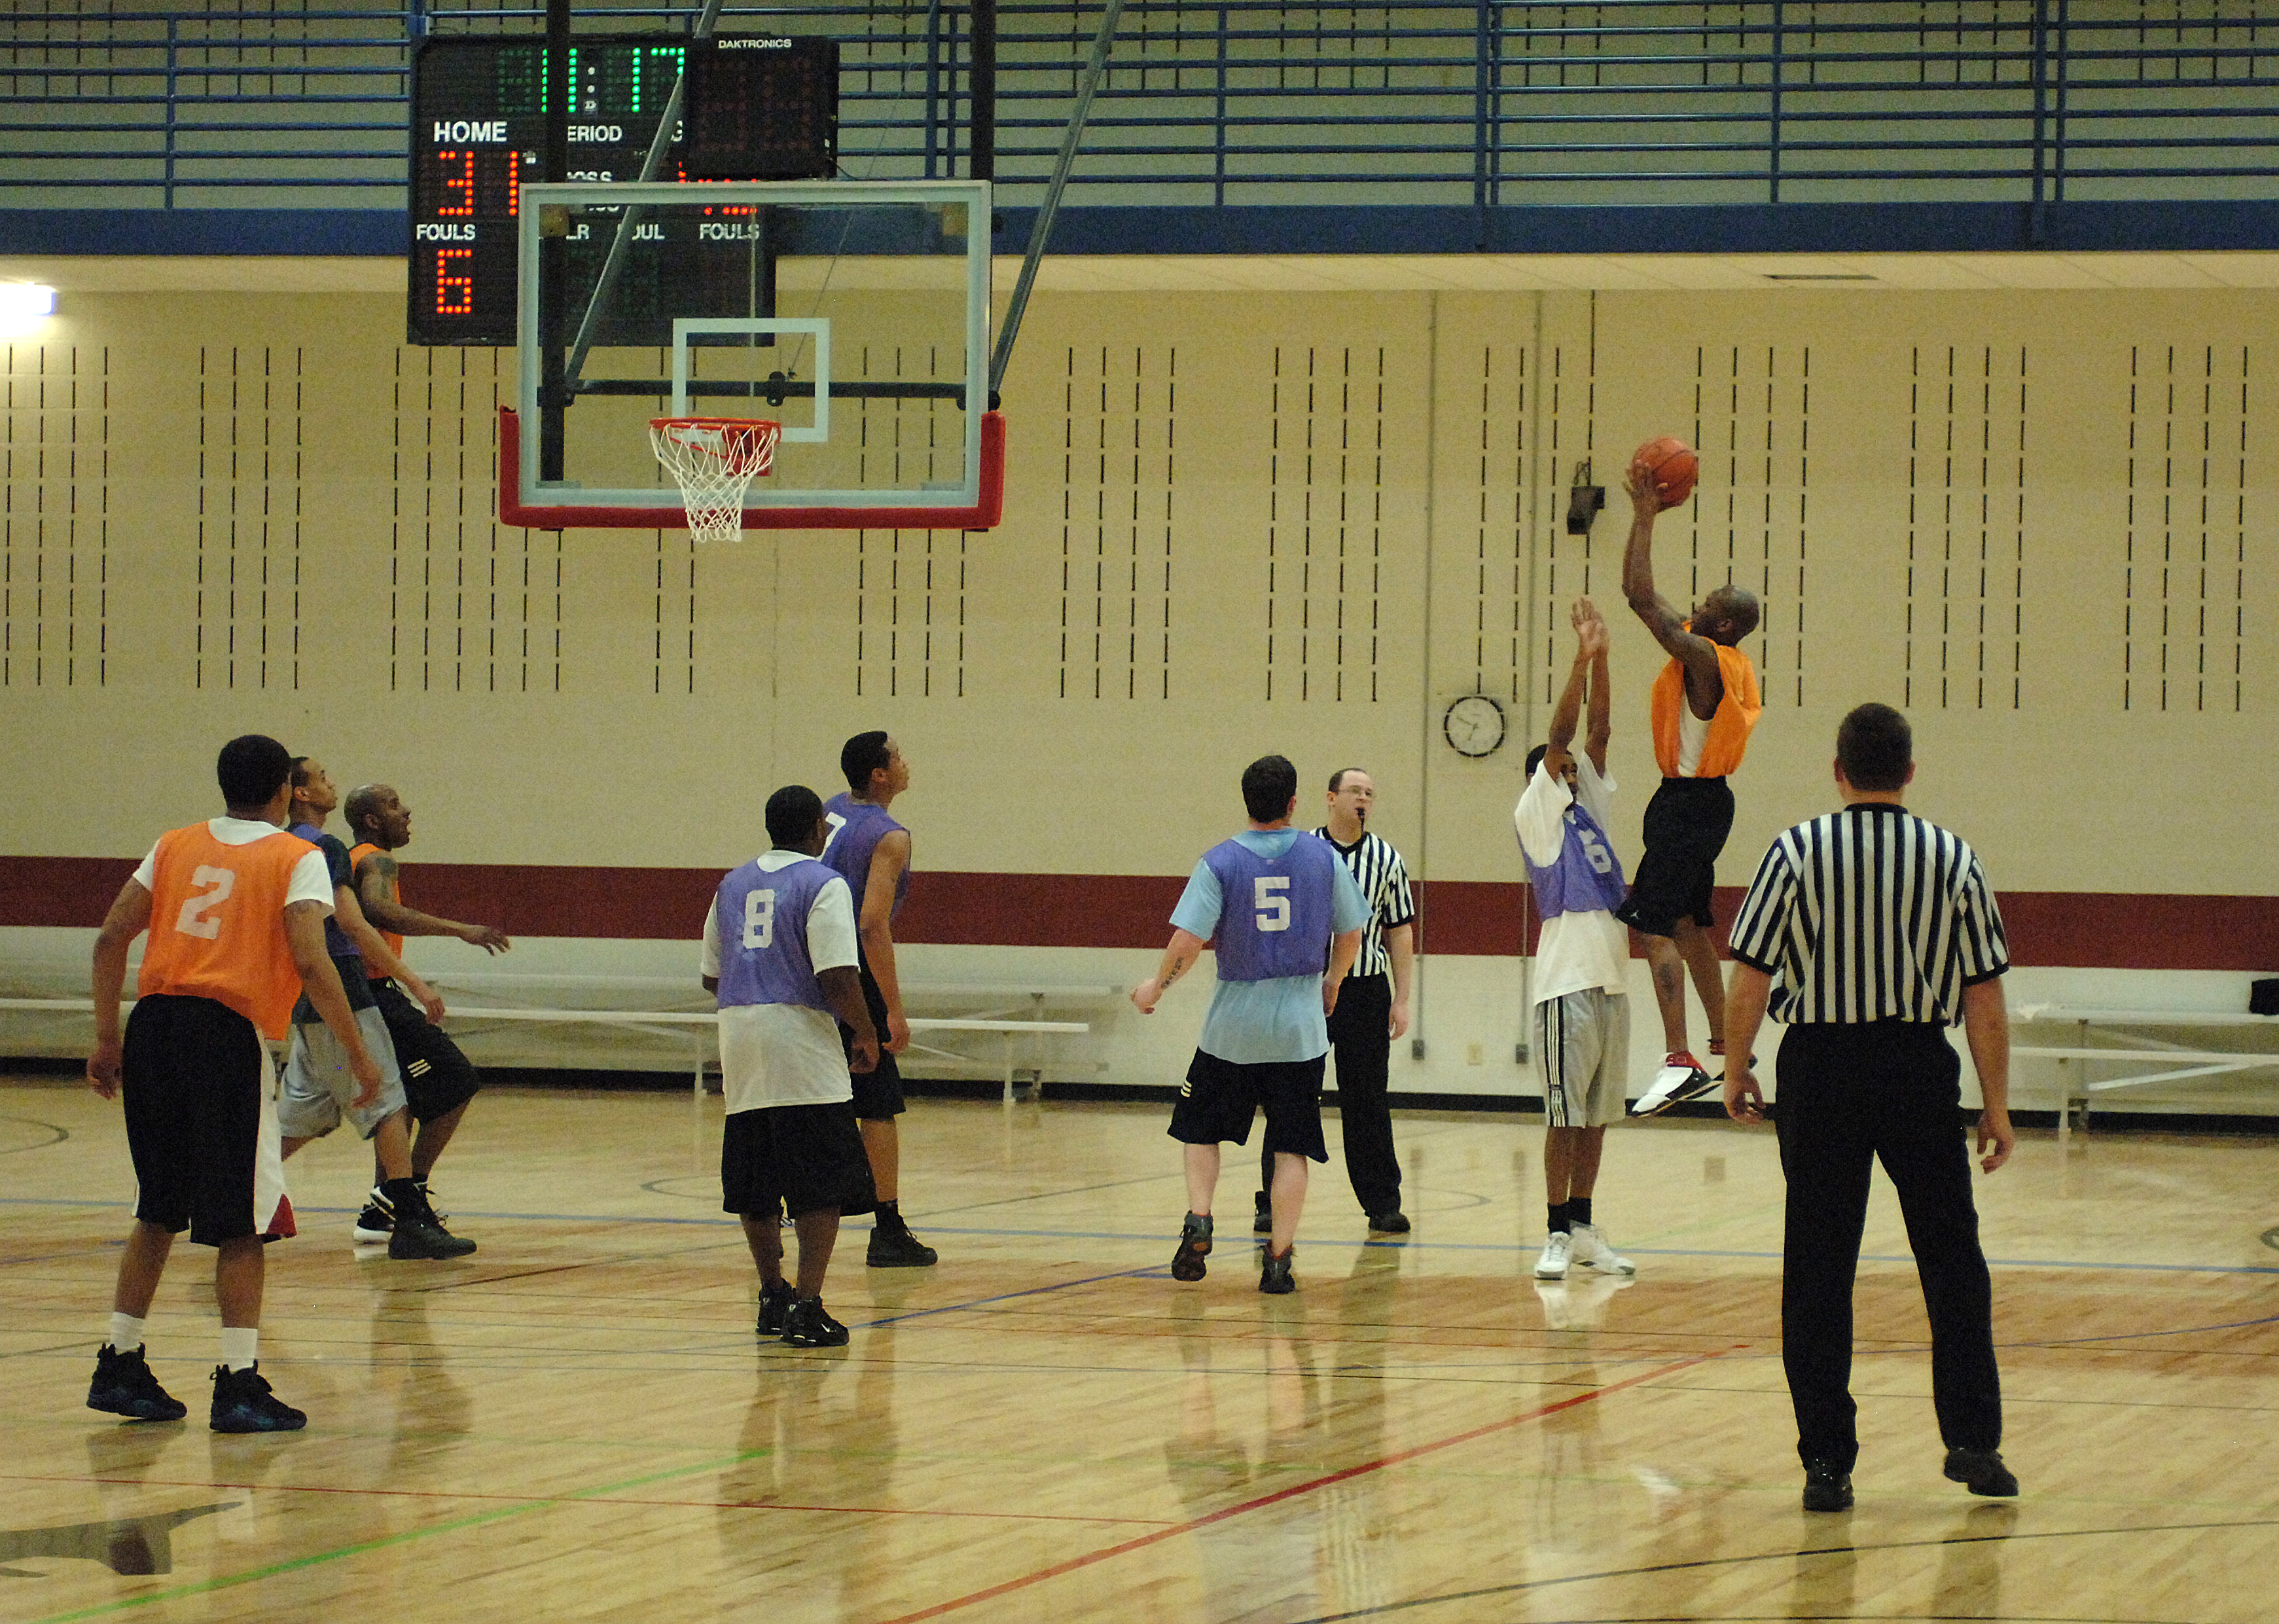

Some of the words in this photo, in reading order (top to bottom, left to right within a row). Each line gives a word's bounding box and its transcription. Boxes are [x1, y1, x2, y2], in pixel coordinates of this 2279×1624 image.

[718, 39, 791, 48] DAKTRONICS
[434, 121, 507, 142] HOME
[567, 126, 622, 142] ERIOD
[439, 151, 518, 215] 31
[416, 224, 476, 240] FOULS
[700, 223, 760, 240] FOULS
[437, 249, 472, 314] 6
[819, 812, 847, 862] 7
[1579, 828, 1612, 874] 6
[175, 865, 236, 940] 2
[743, 889, 775, 948] 8
[1255, 876, 1291, 931] 5
